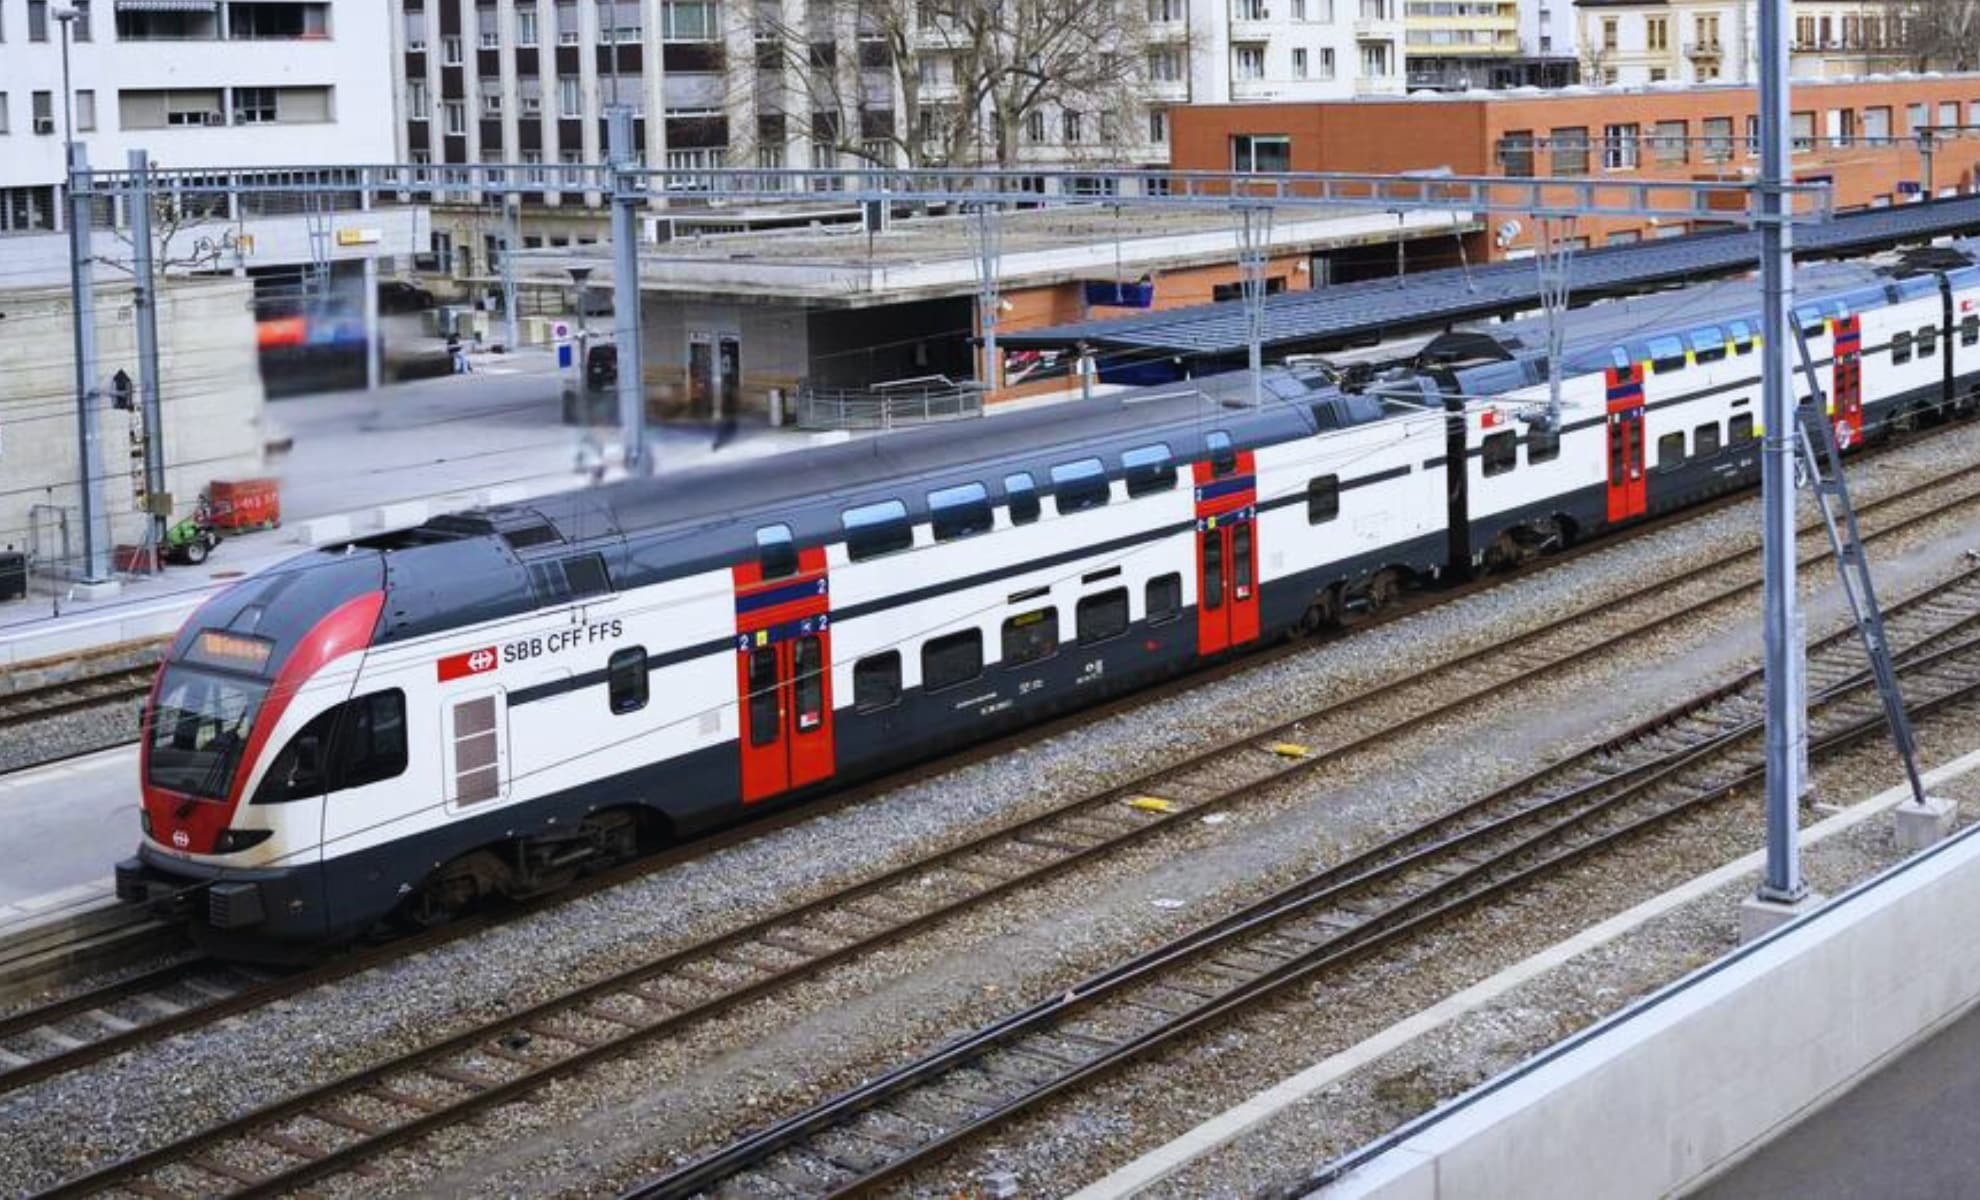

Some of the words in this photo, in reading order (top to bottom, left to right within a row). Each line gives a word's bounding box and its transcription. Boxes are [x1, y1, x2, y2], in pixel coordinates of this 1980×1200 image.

[816, 578, 827, 594] 2
[819, 614, 828, 631] 2
[503, 638, 542, 663] SBB
[547, 629, 582, 653] CFF
[588, 619, 622, 644] FFS
[739, 634, 749, 650] 2
